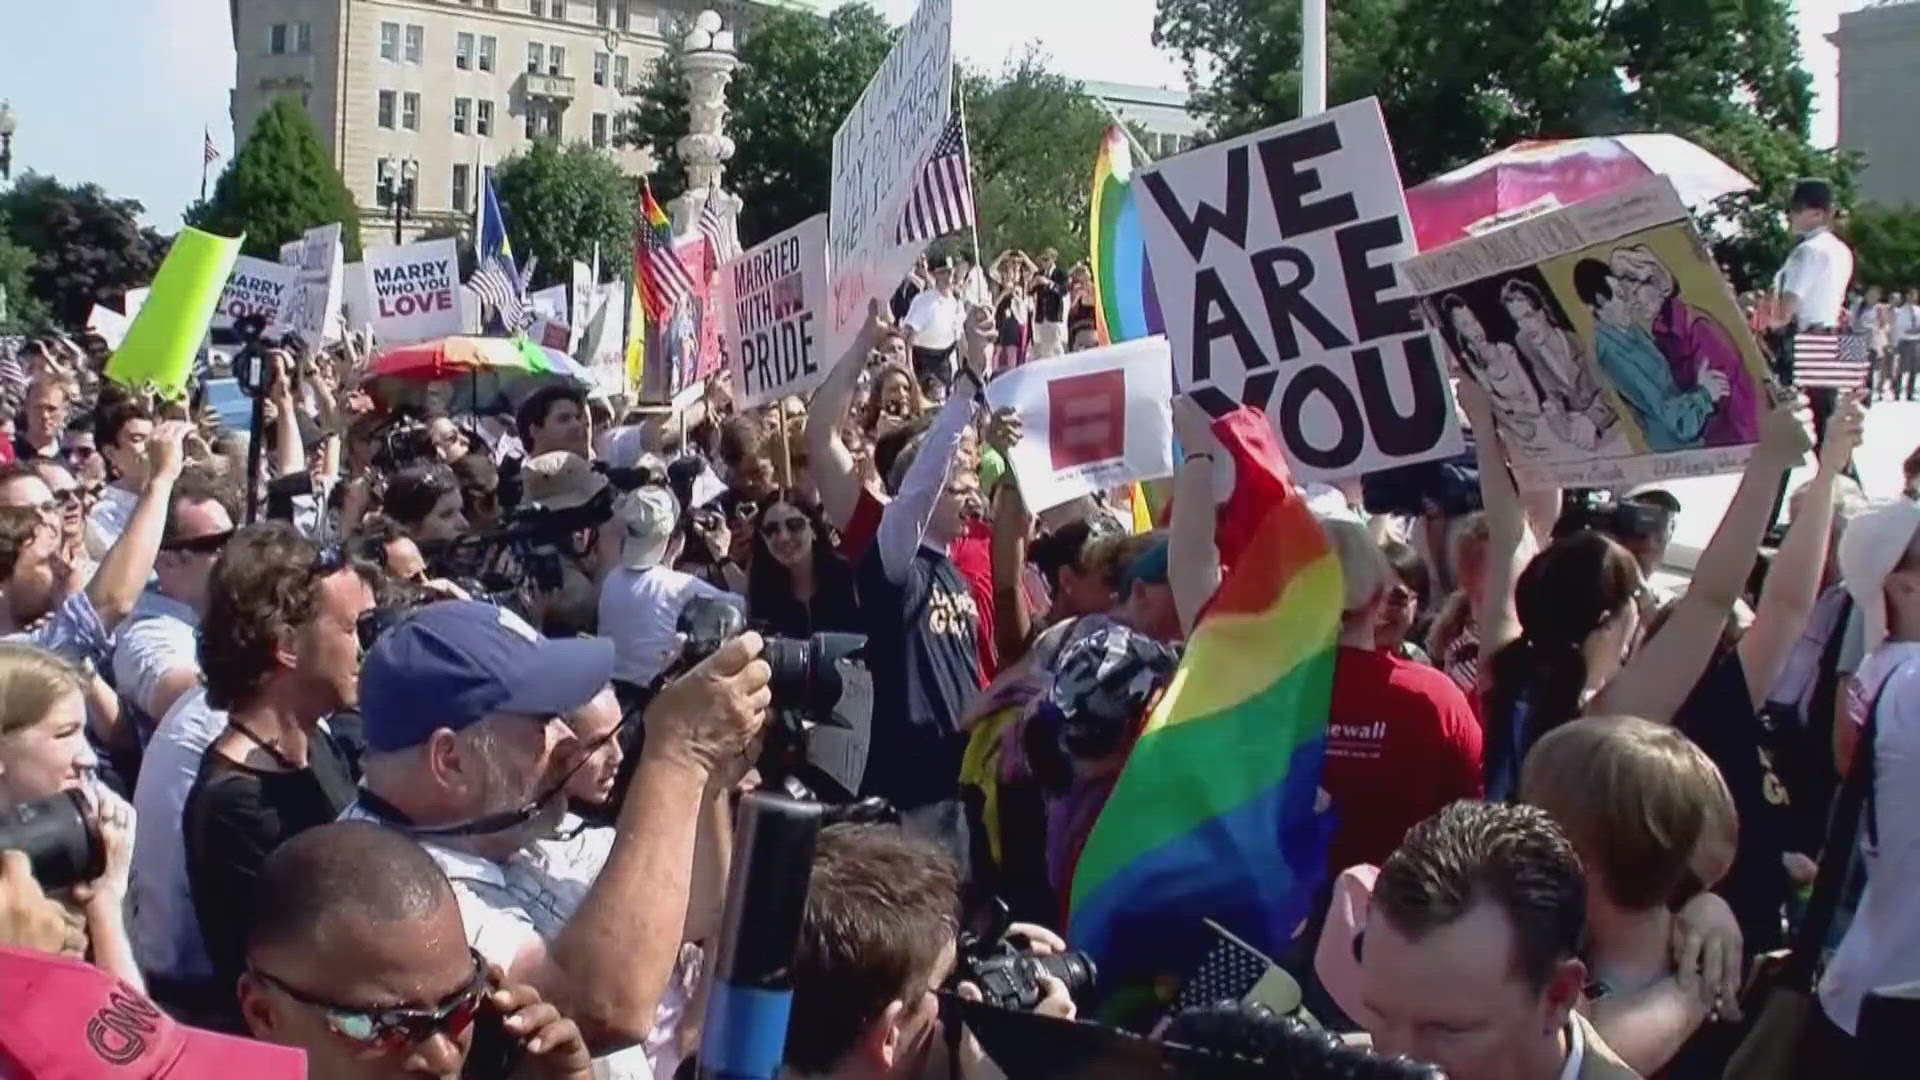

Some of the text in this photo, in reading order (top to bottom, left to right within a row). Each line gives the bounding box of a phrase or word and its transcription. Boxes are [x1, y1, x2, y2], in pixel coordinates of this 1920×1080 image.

[1141, 120, 1360, 264] WE
[373, 260, 449, 284] MARRY
[376, 277, 450, 296] WHO YOU
[734, 235, 801, 300] MARRIED
[1192, 215, 1425, 383] ARE
[378, 289, 453, 319] LOVE
[736, 289, 773, 337] WITH
[741, 310, 818, 397] PRIDE
[86, 979, 160, 1066] CNN
